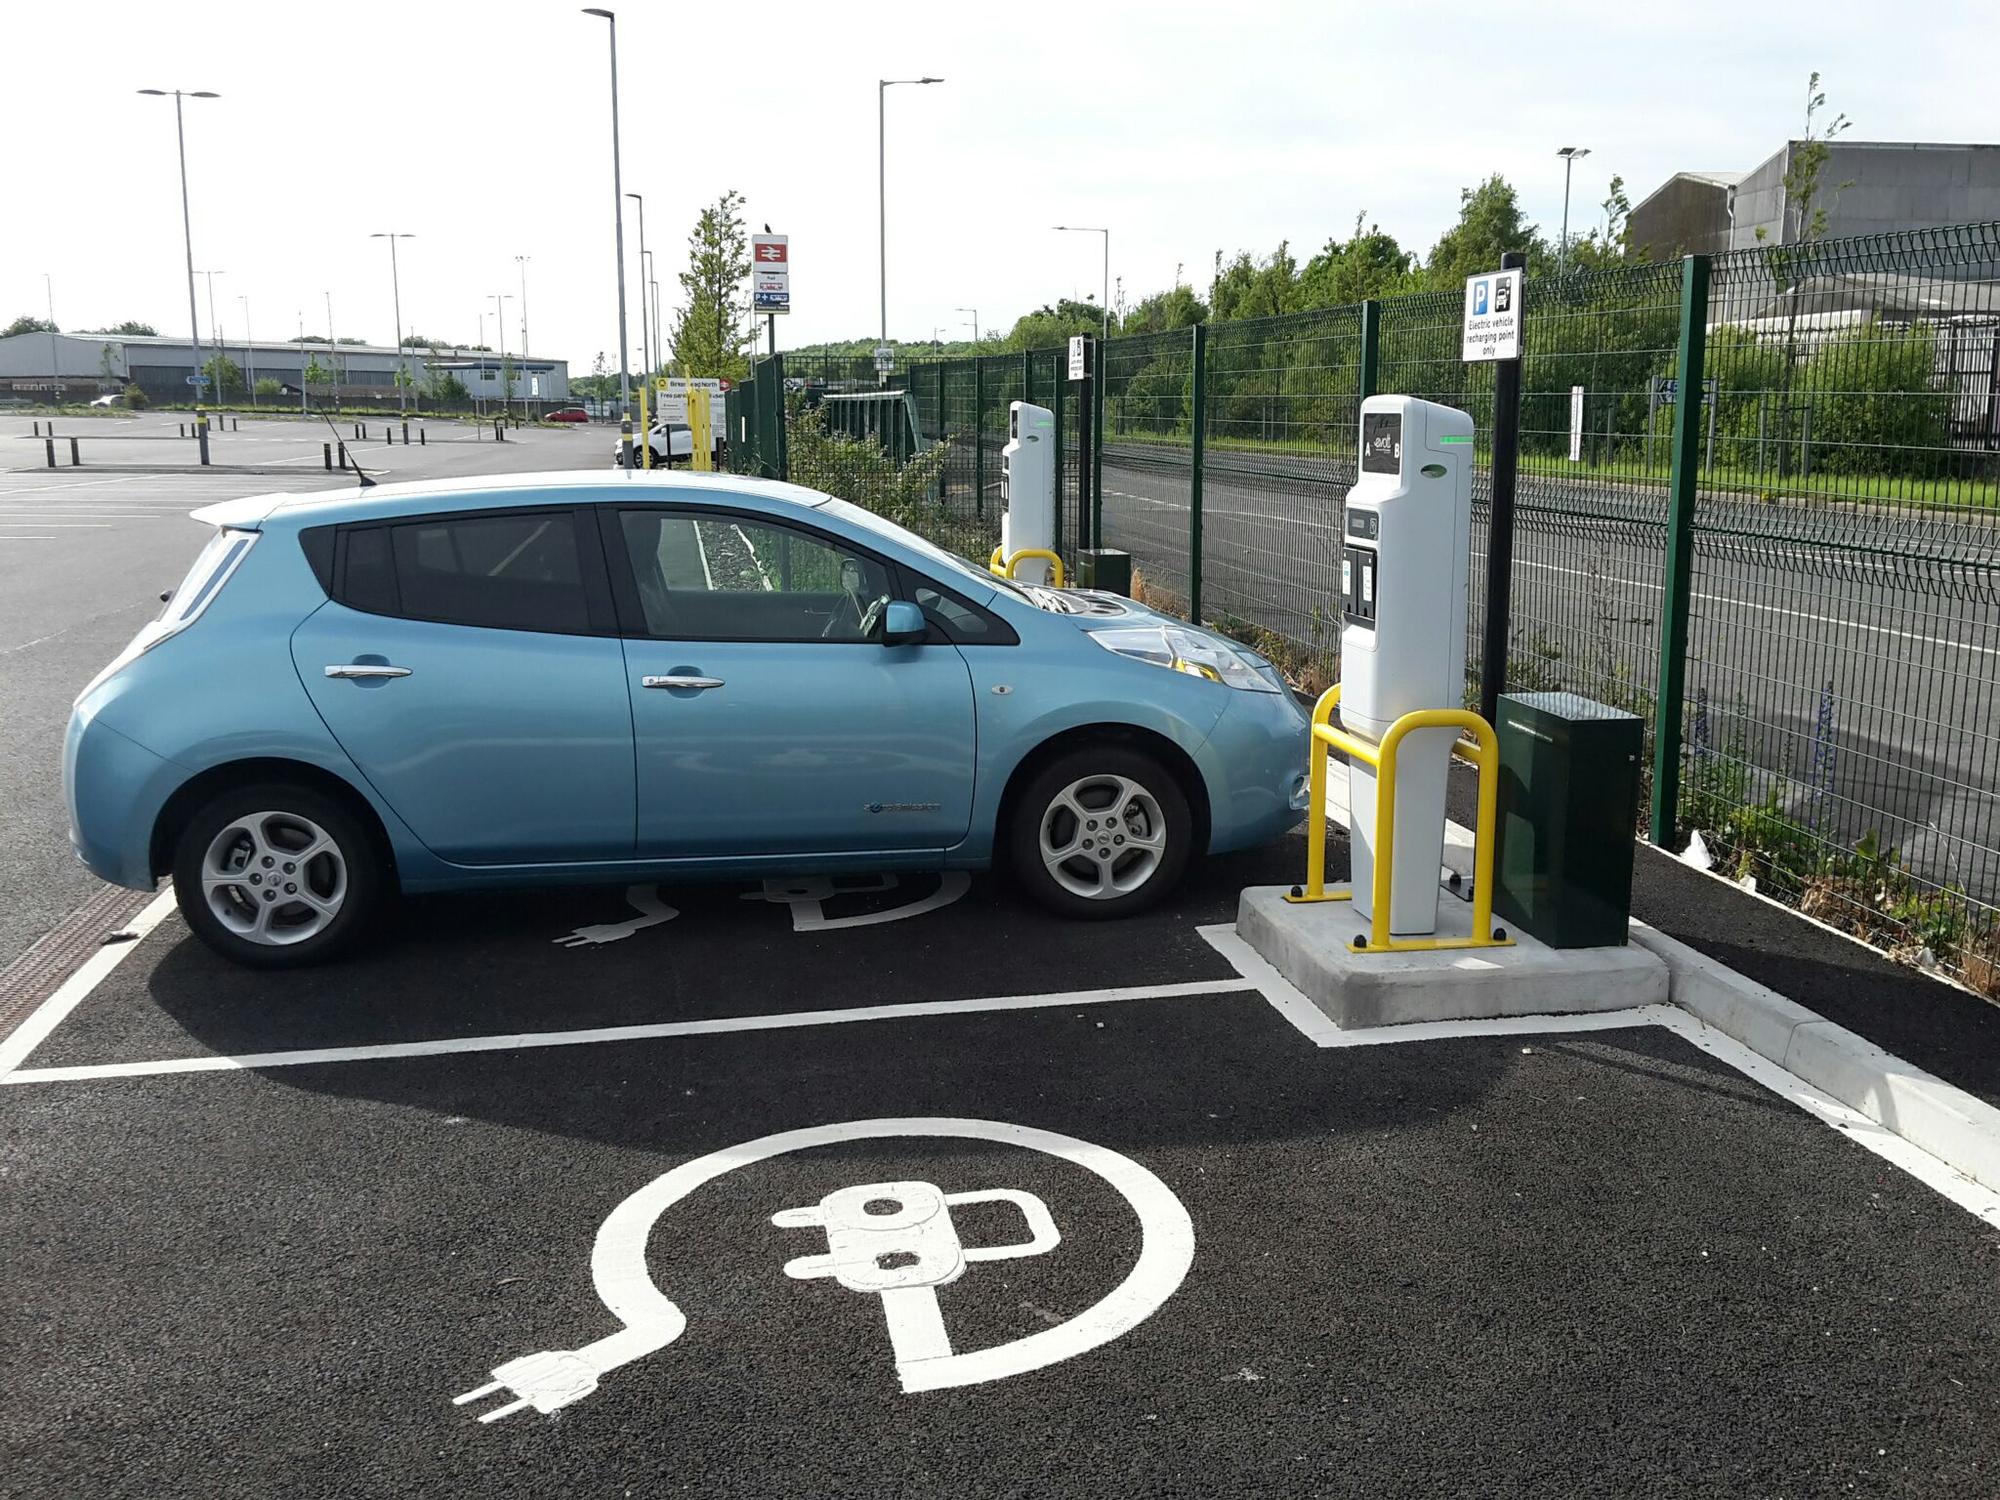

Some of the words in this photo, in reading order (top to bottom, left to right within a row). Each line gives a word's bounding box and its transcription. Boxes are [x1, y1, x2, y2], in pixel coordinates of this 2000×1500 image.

[1475, 284, 1486, 312] P
[1468, 318, 1491, 330] Electric
[1492, 316, 1514, 328] vehicle
[1466, 332, 1497, 344] recharging
[1498, 330, 1515, 342] point
[1482, 345, 1496, 356] only
[1365, 441, 1371, 457] A
[1394, 442, 1400, 459] B
